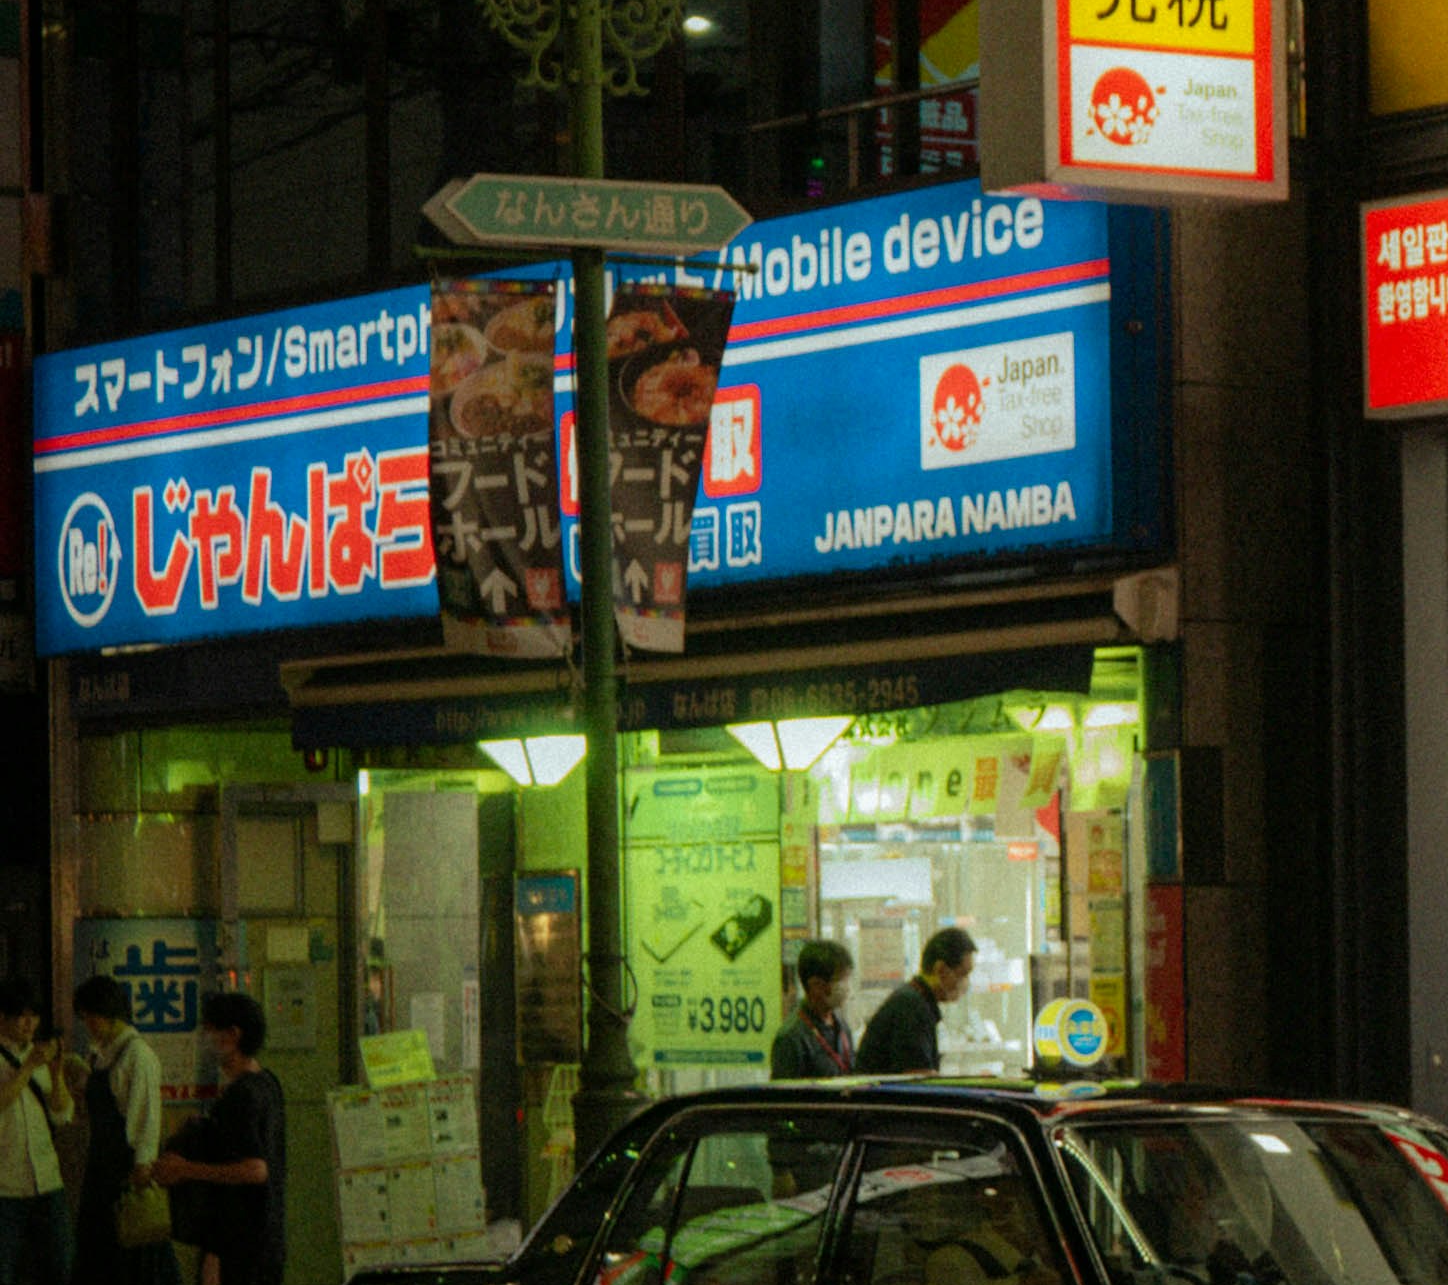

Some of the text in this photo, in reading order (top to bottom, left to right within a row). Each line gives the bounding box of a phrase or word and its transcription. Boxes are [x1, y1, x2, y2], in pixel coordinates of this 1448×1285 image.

[882, 197, 1045, 275] device
[1021, 413, 1063, 441] Shop
[437, 505, 561, 563] ホール
[815, 480, 1077, 554] JANPARA NAMBA
